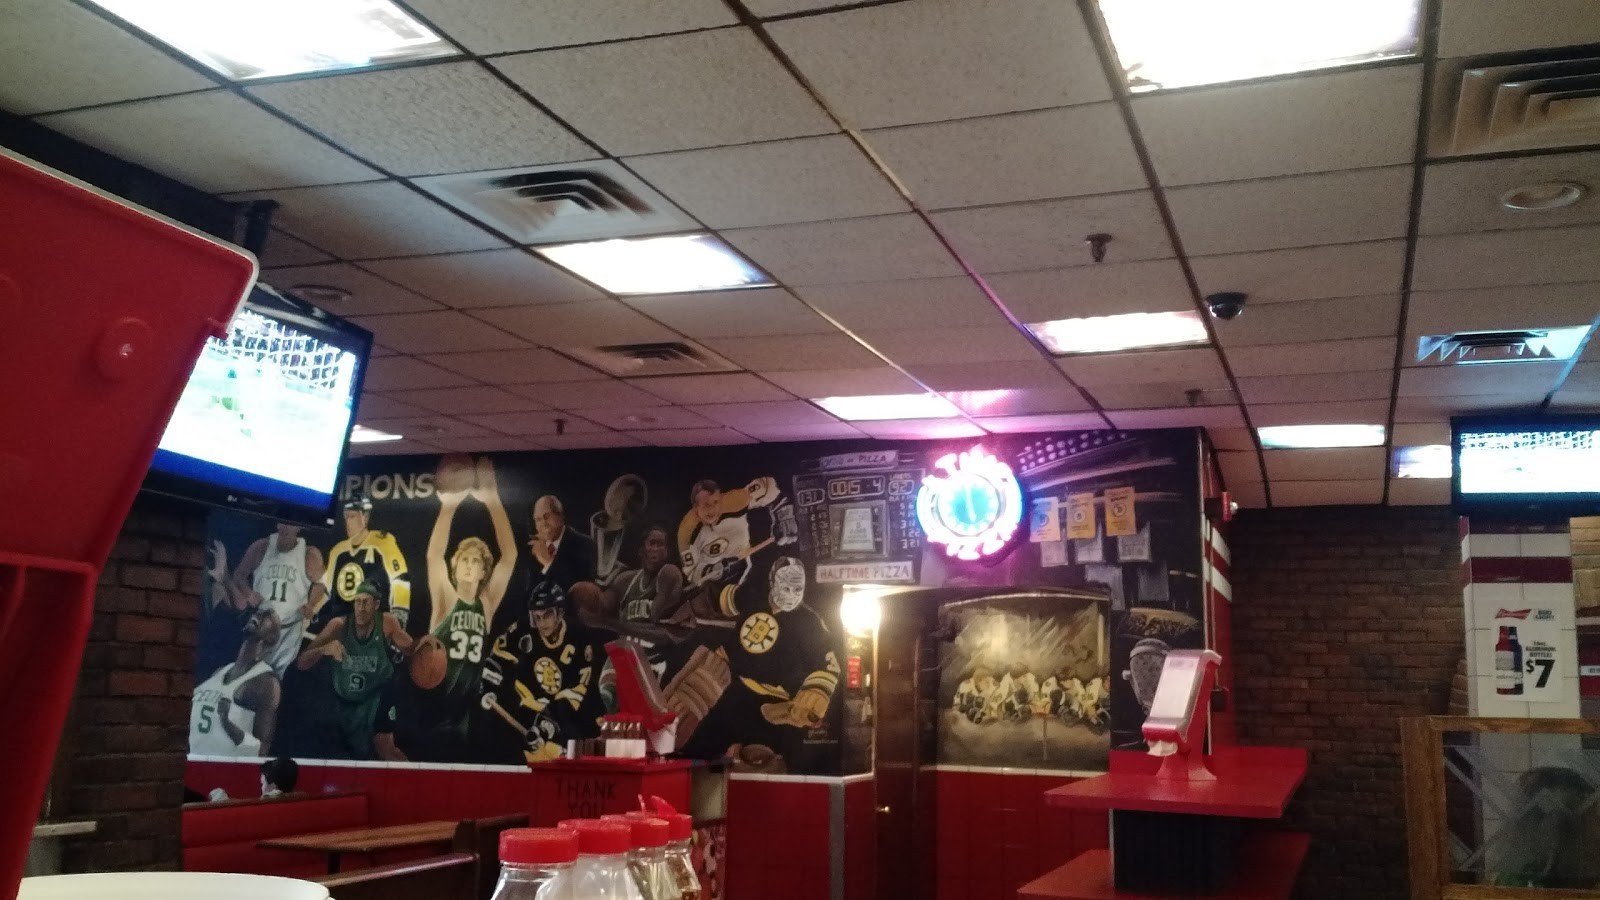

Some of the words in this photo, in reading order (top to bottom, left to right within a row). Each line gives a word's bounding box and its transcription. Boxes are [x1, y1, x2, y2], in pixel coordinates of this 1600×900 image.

[339, 473, 435, 500] PIONS
[344, 571, 356, 591] B
[873, 565, 909, 578] PIZZA
[269, 580, 288, 602] 11
[450, 610, 485, 636] CELTICS
[449, 630, 484, 663] 33
[560, 644, 576, 665] C
[1525, 658, 1556, 688] $7
[197, 704, 215, 734] 5
[554, 778, 617, 800] THANK
